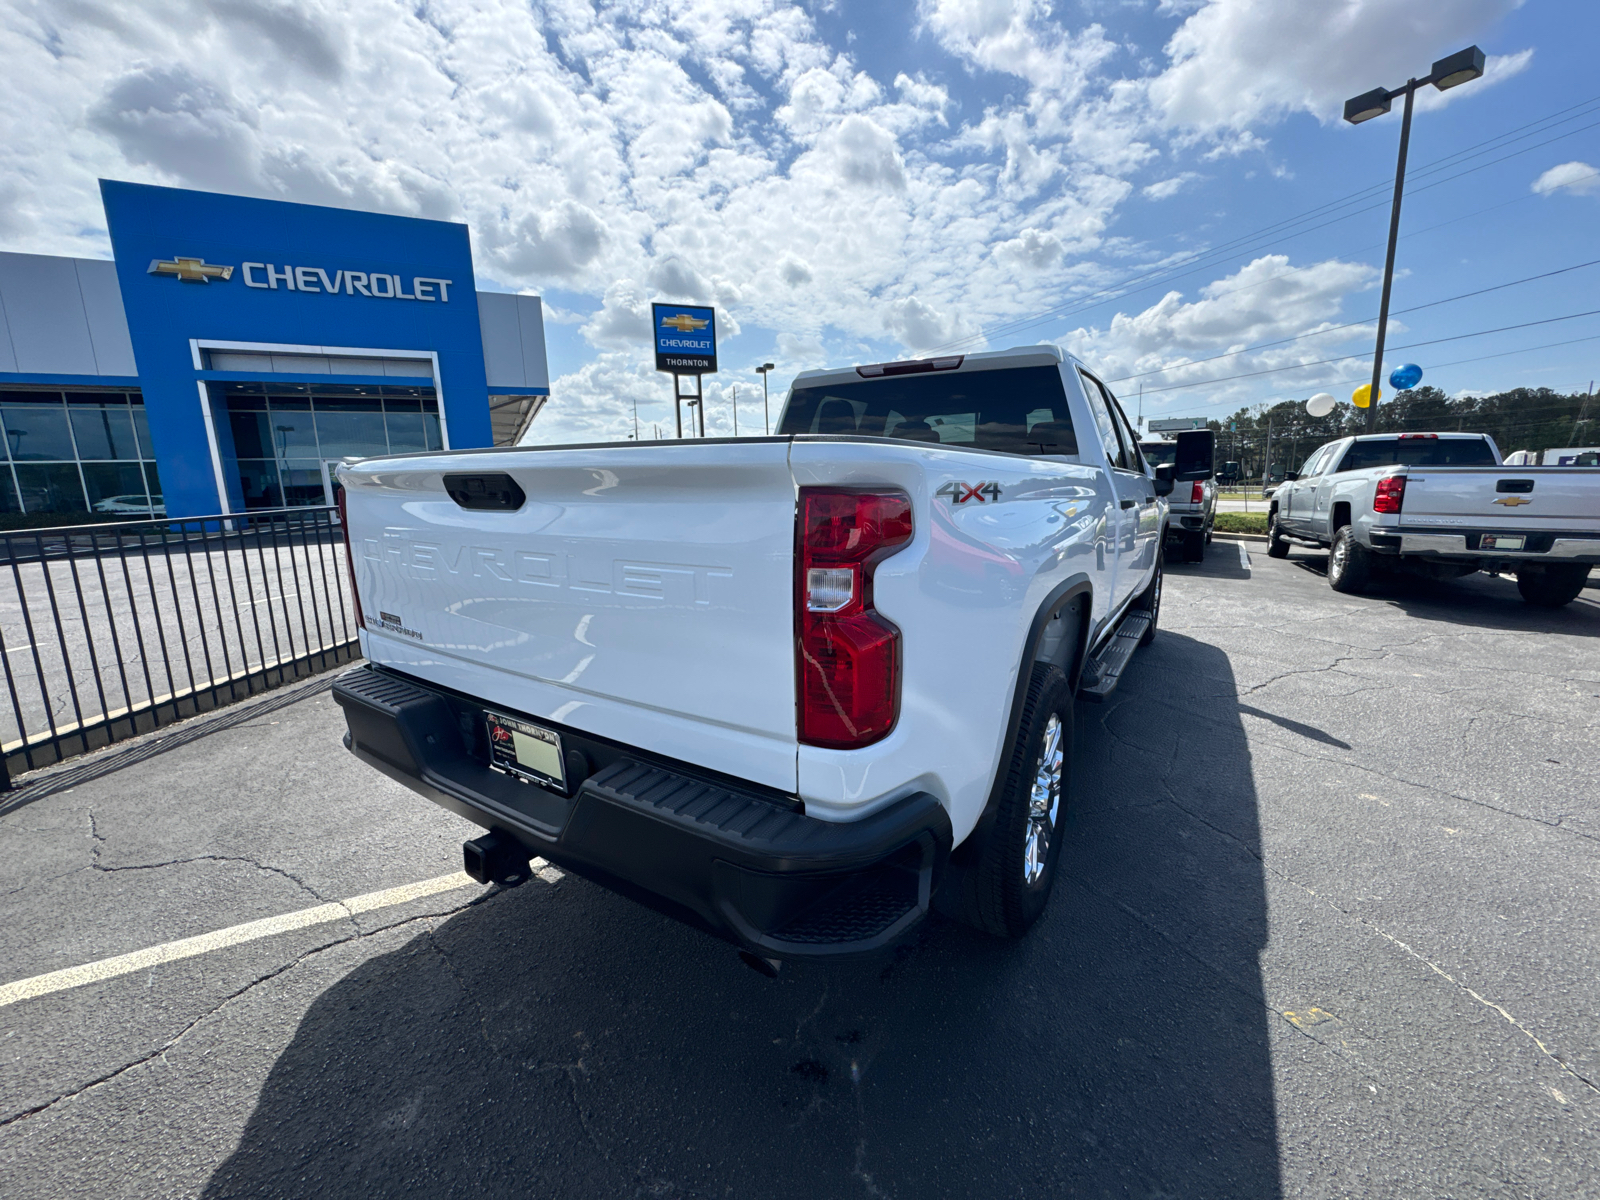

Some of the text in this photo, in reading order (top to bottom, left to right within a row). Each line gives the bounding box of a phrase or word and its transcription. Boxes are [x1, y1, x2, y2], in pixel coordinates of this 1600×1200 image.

[242, 261, 453, 302] CHEVROLET
[660, 338, 711, 349] CHEVROLET
[666, 358, 709, 367] THORNTON
[936, 481, 1003, 504] 4X4
[362, 536, 734, 606] CHEVROLET
[499, 717, 517, 729] JOHN
